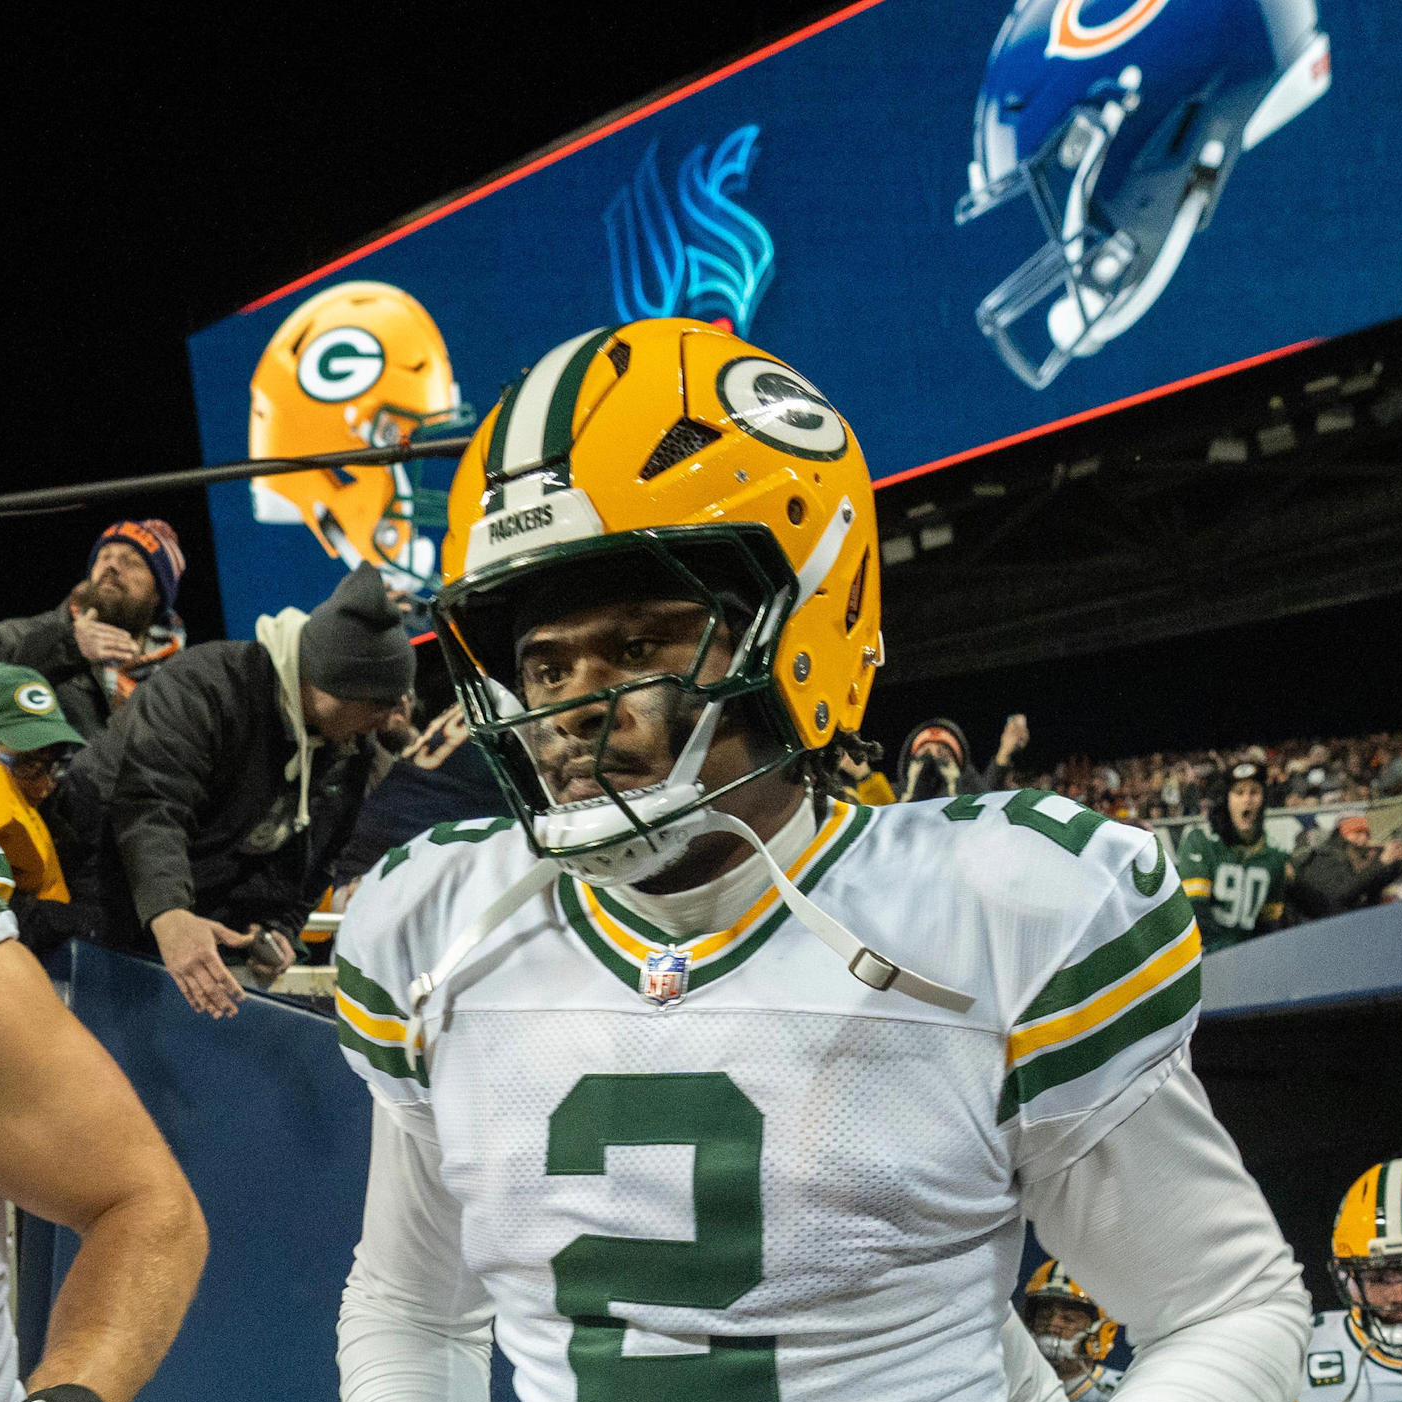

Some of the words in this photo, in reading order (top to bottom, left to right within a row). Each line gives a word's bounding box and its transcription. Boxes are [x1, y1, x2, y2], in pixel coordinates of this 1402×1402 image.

[299, 328, 384, 400] G
[488, 504, 553, 546] PACKERS
[1211, 862, 1271, 930] 90
